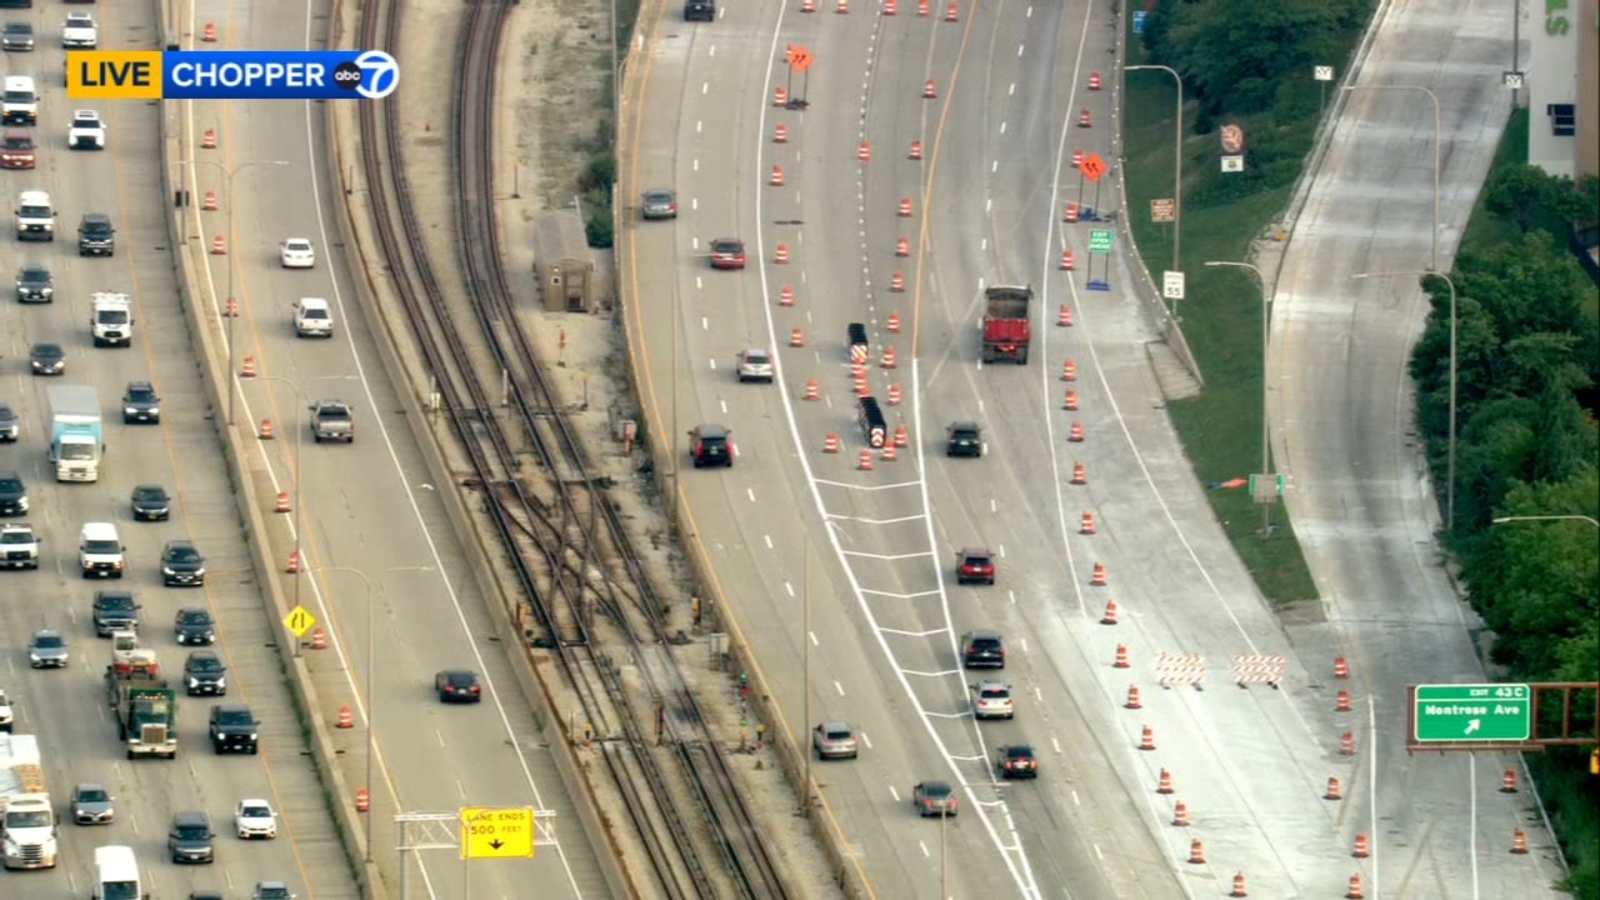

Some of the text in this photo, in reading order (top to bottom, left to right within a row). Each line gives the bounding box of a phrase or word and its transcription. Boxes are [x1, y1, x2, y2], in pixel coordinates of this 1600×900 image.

[1167, 286, 1181, 296] 55
[1469, 688, 1489, 696] EXIT
[1425, 704, 1520, 716] Montrose Ave
[467, 812, 525, 822] LANE ENDS
[470, 825, 522, 835] 500 FEET
